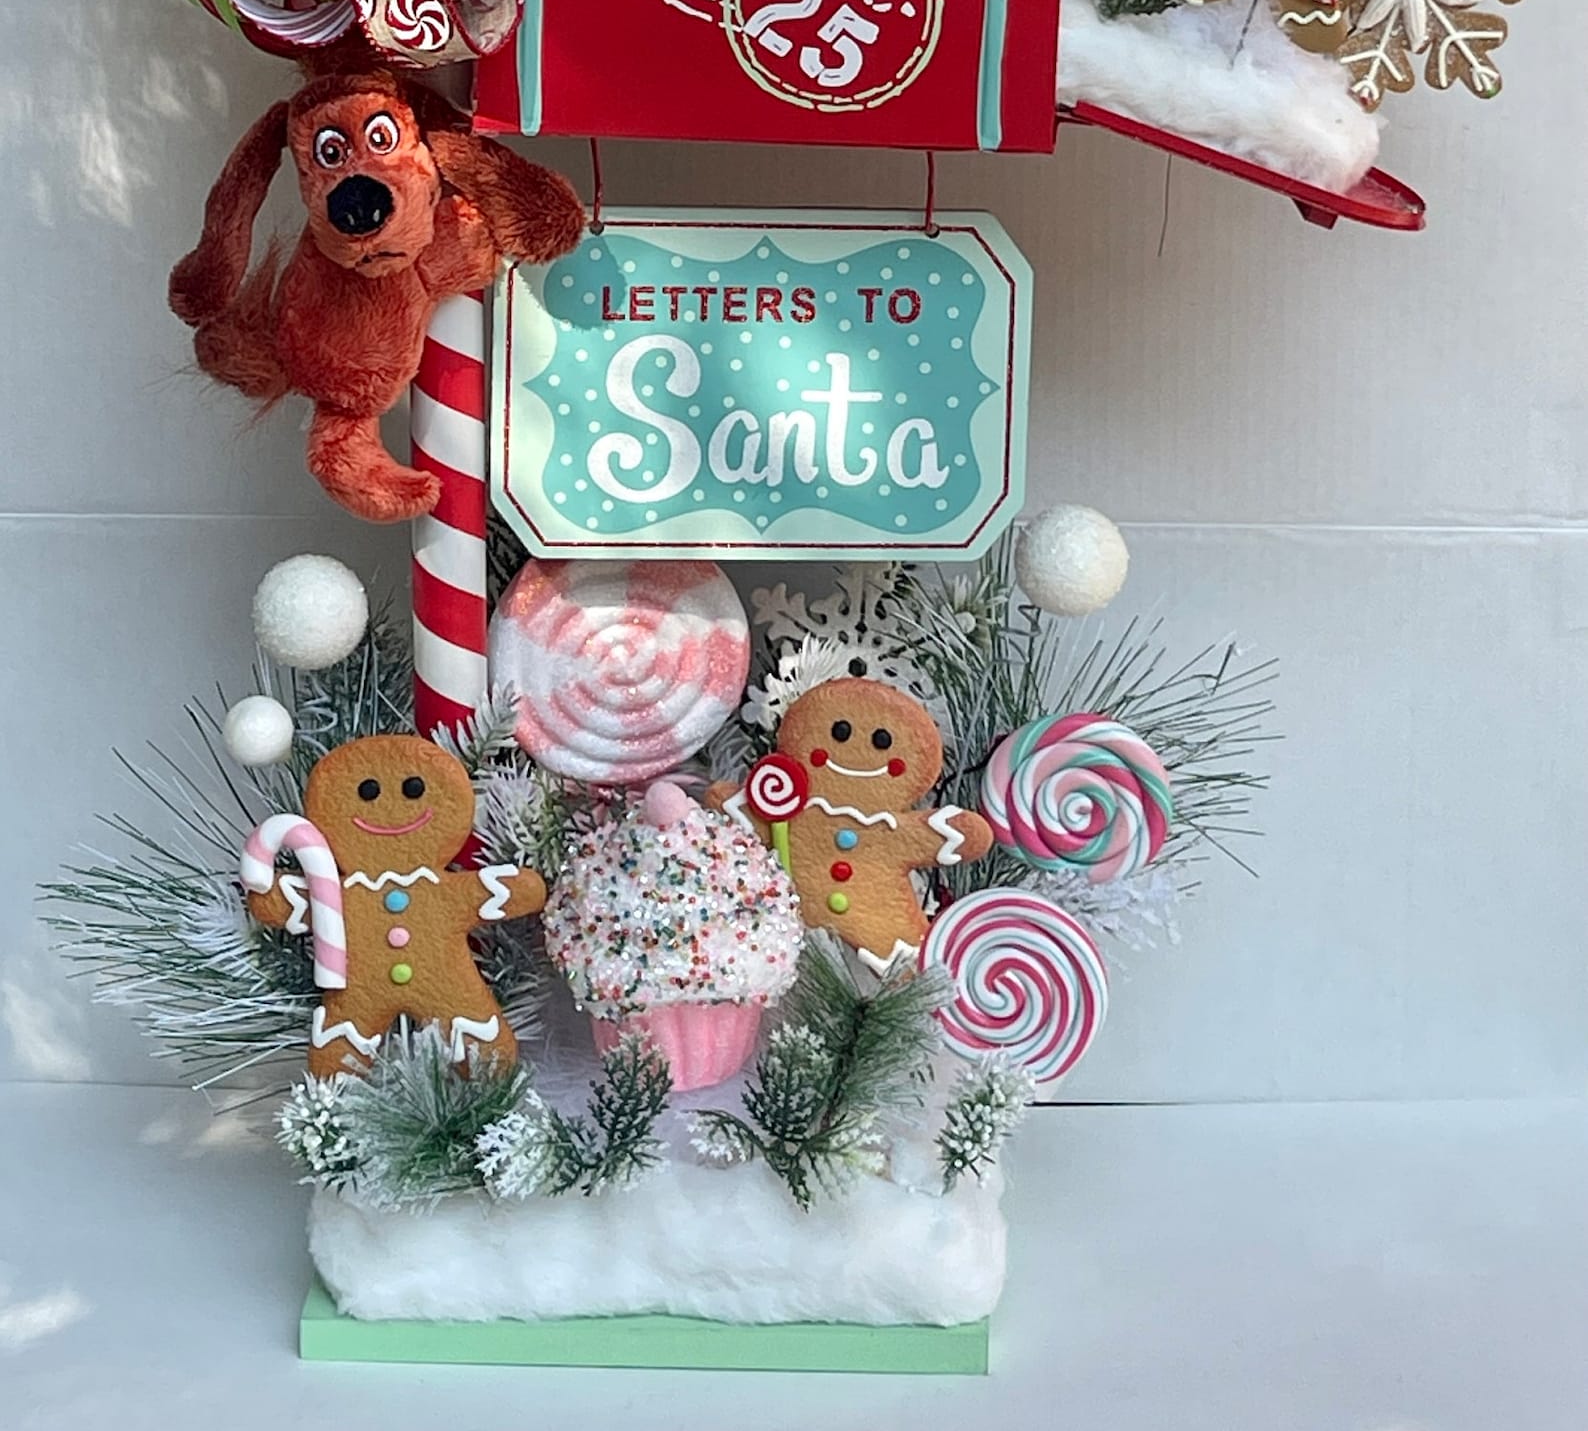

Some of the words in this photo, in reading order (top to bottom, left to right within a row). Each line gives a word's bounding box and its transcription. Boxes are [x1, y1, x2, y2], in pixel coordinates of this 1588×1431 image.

[600, 285, 818, 324] LETTERS
[857, 287, 923, 325] TO
[586, 333, 950, 503] Santa
